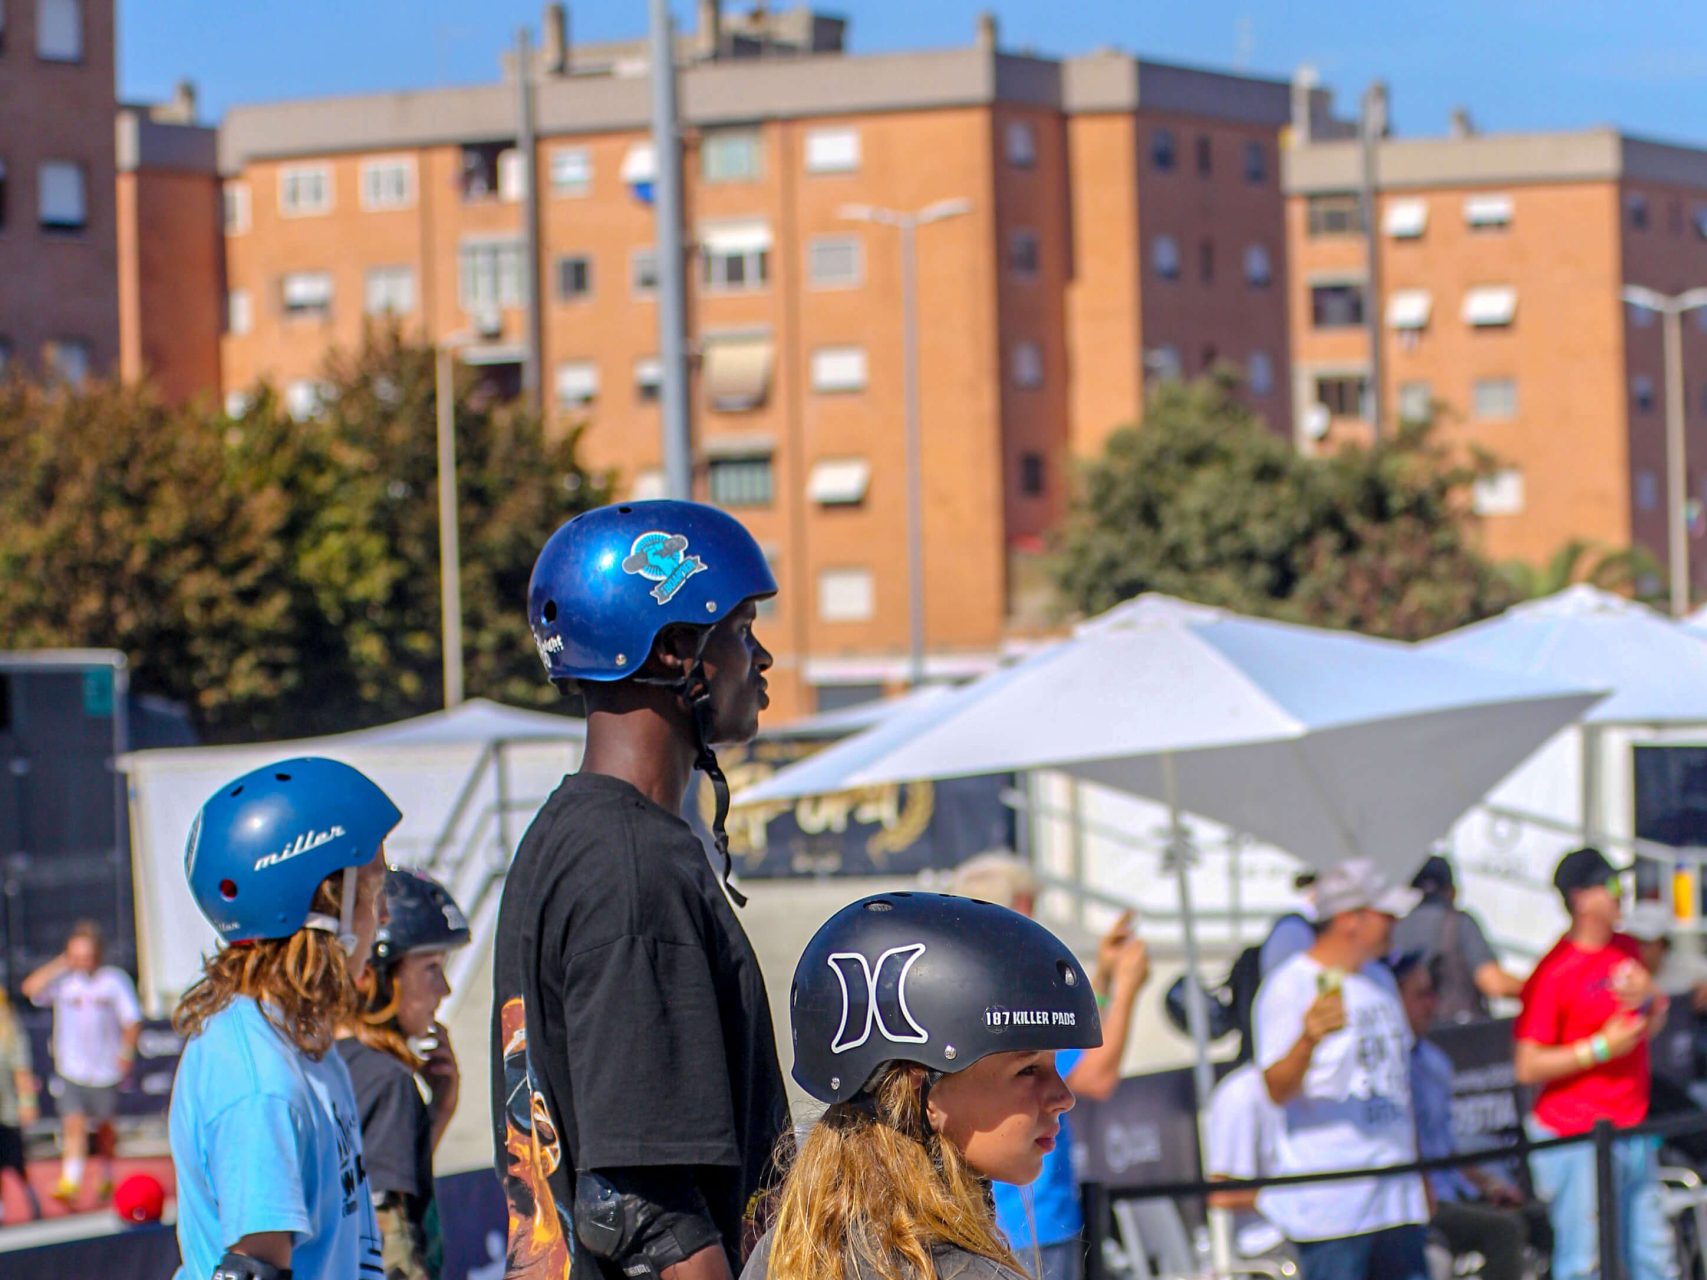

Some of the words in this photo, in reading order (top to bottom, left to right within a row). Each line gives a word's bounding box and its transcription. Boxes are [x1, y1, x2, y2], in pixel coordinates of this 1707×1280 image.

[253, 825, 346, 872] miller
[985, 1011, 1010, 1026] 187
[1012, 1011, 1050, 1025] KILLER
[1051, 1012, 1077, 1026] PADS
